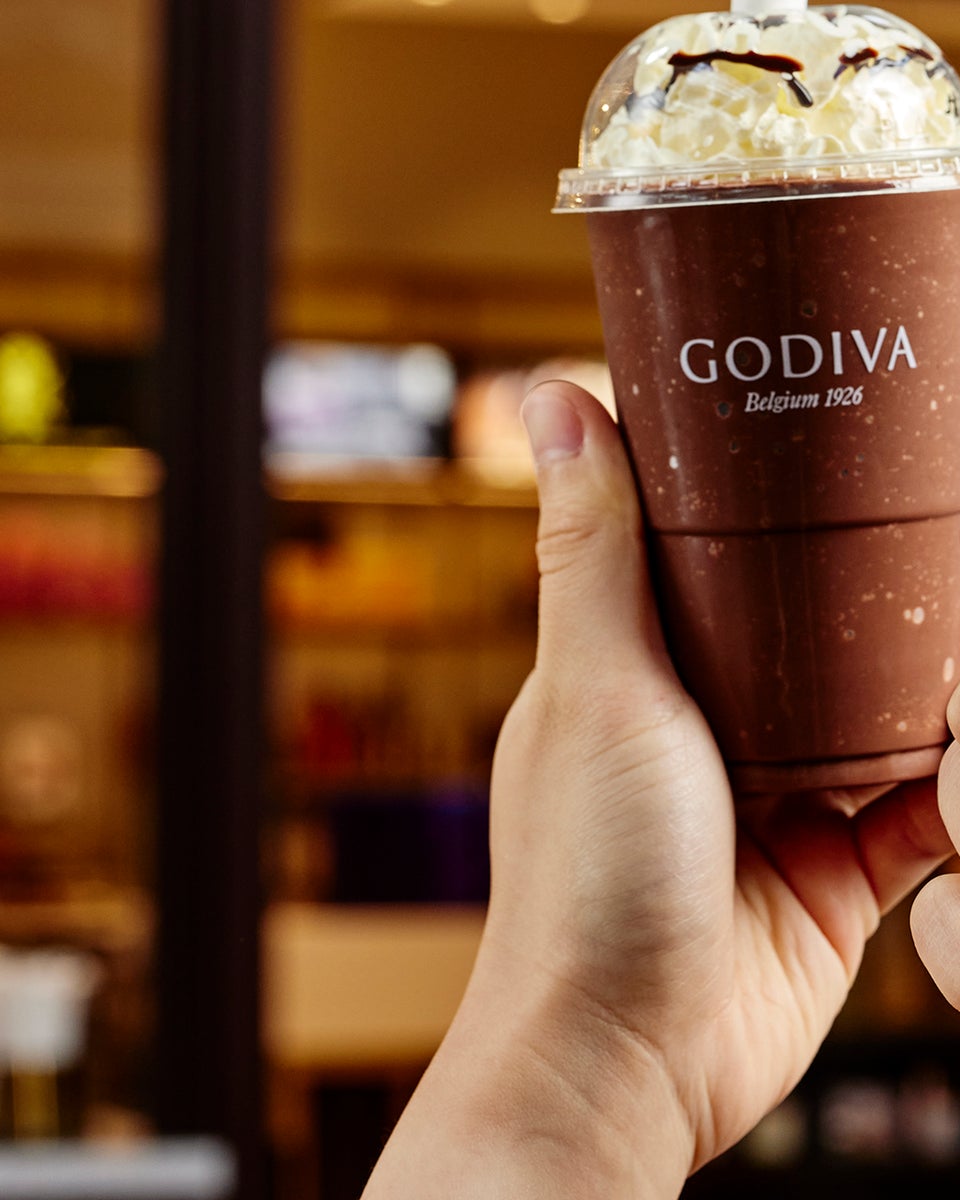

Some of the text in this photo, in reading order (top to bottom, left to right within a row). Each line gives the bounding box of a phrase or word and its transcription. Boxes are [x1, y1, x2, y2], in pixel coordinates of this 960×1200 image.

[679, 325, 917, 384] GODIVA
[744, 385, 864, 414] Belgium 1926
